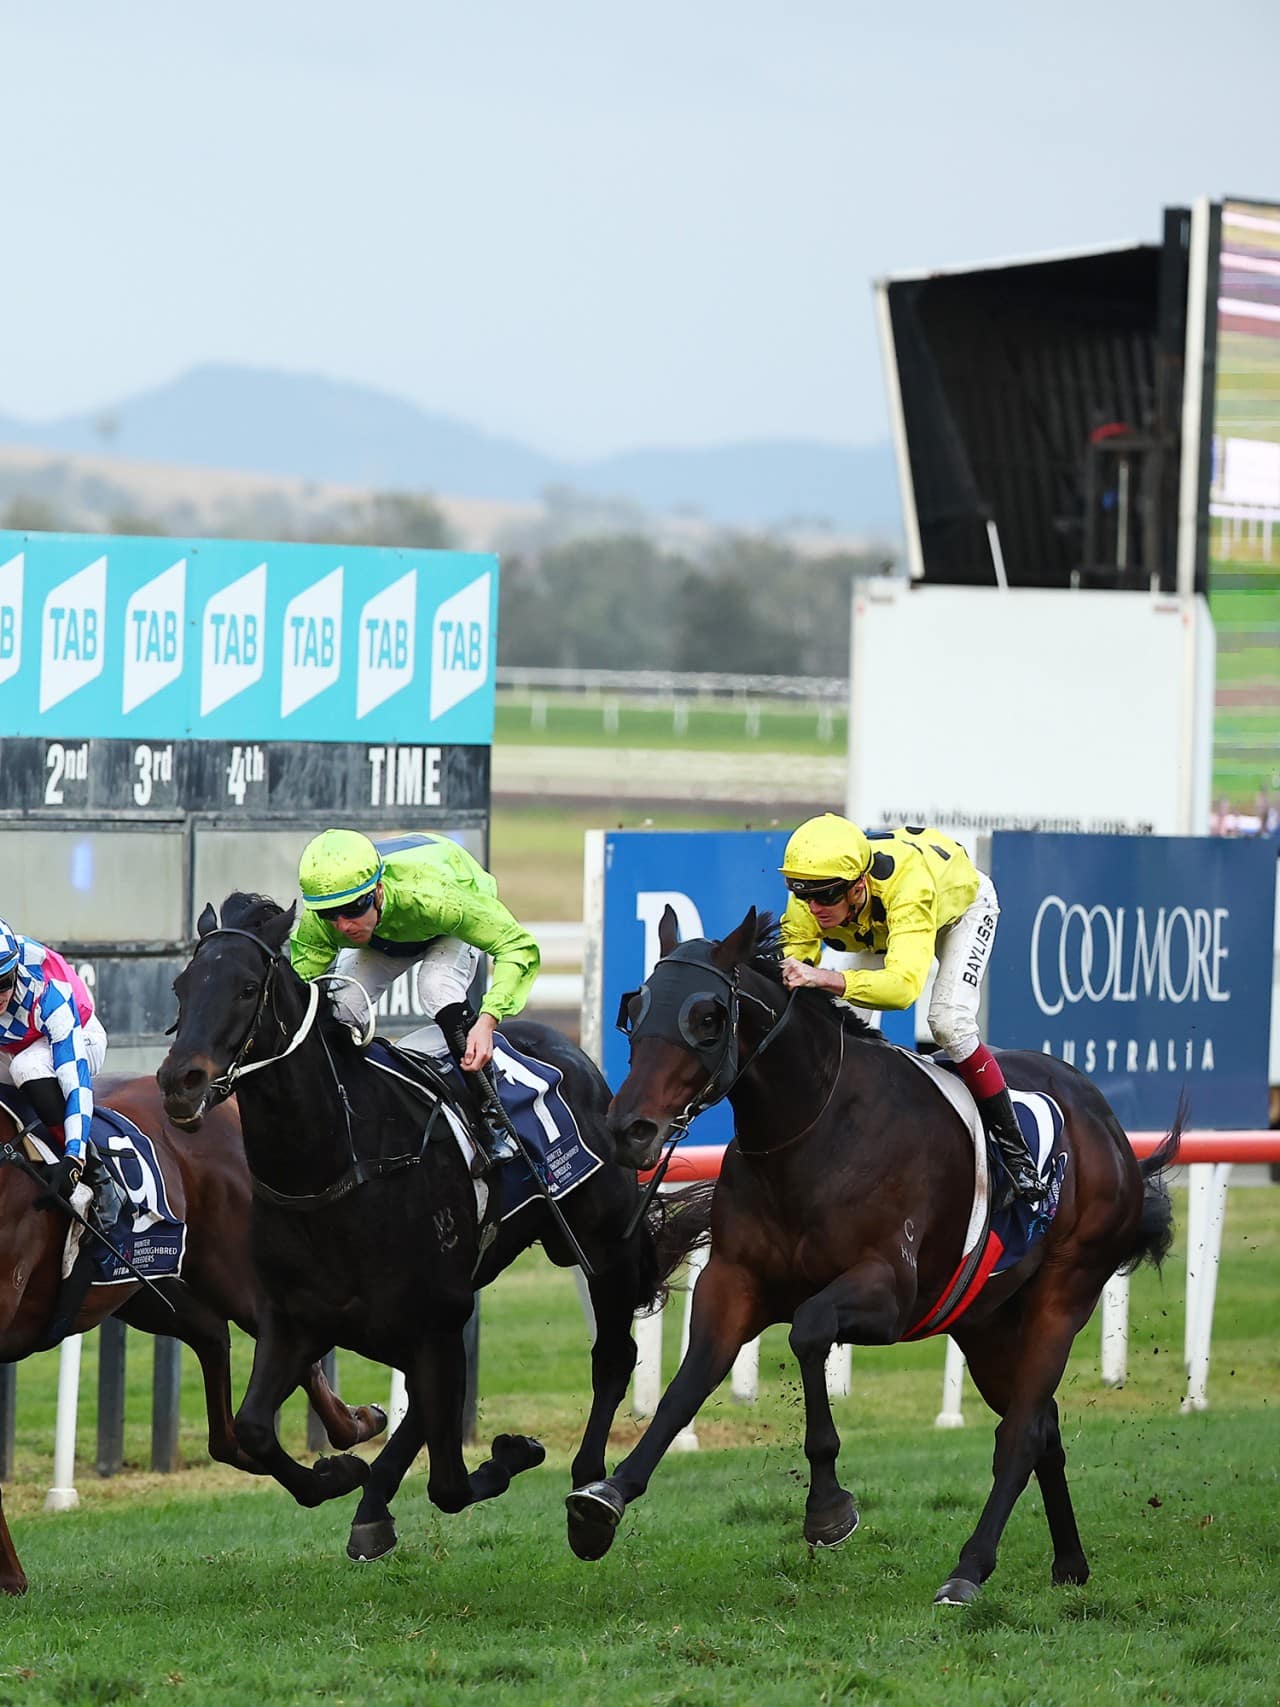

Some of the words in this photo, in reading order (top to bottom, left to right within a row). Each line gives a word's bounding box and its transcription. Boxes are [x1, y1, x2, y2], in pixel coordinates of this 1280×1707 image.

[49, 607, 98, 662] TAB
[132, 609, 178, 663] TAB
[210, 613, 258, 666] TAB
[290, 615, 335, 668] TAB
[365, 618, 409, 670] TAB
[439, 620, 482, 671] TAB
[44, 743, 89, 805] 2nd
[133, 744, 173, 806] 3rd
[226, 745, 265, 806] 4th
[368, 746, 442, 807] TIME
[962, 914, 994, 988] BAYLISS
[1030, 894, 1231, 1016] COOLMORE
